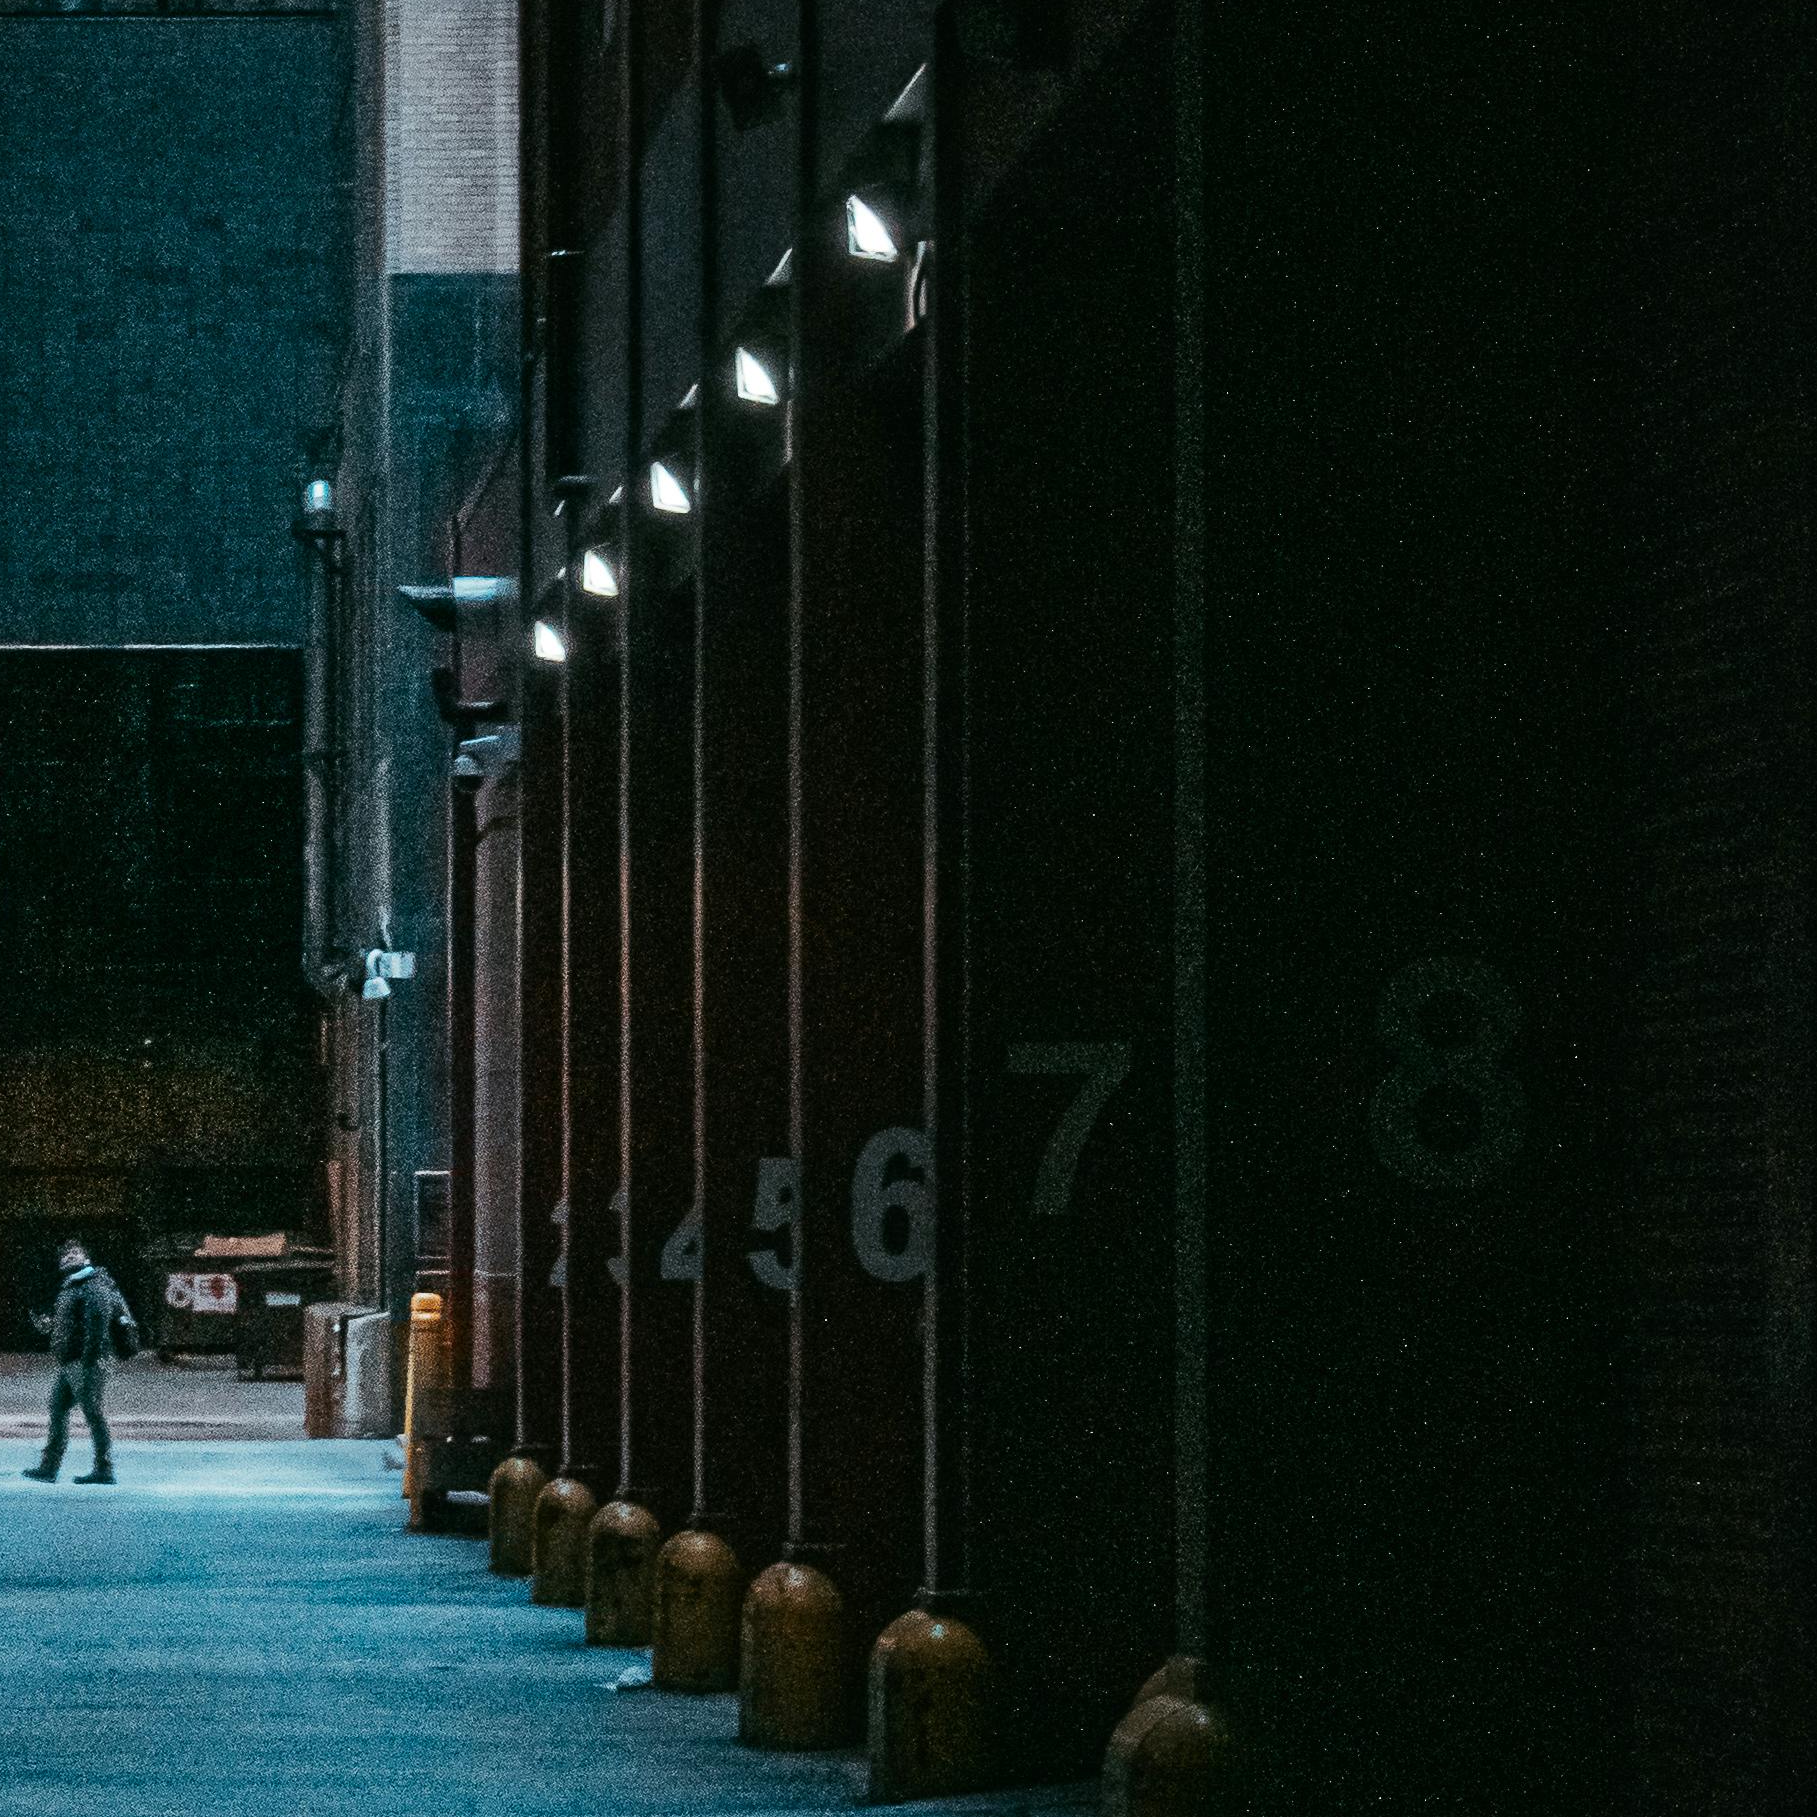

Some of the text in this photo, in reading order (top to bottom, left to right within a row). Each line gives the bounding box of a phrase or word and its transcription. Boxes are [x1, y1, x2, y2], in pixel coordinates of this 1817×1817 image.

[1006, 1041, 1131, 1214] 7
[1369, 954, 1527, 1187] 8
[747, 1158, 801, 1289] 5
[852, 1127, 936, 1282] 6
